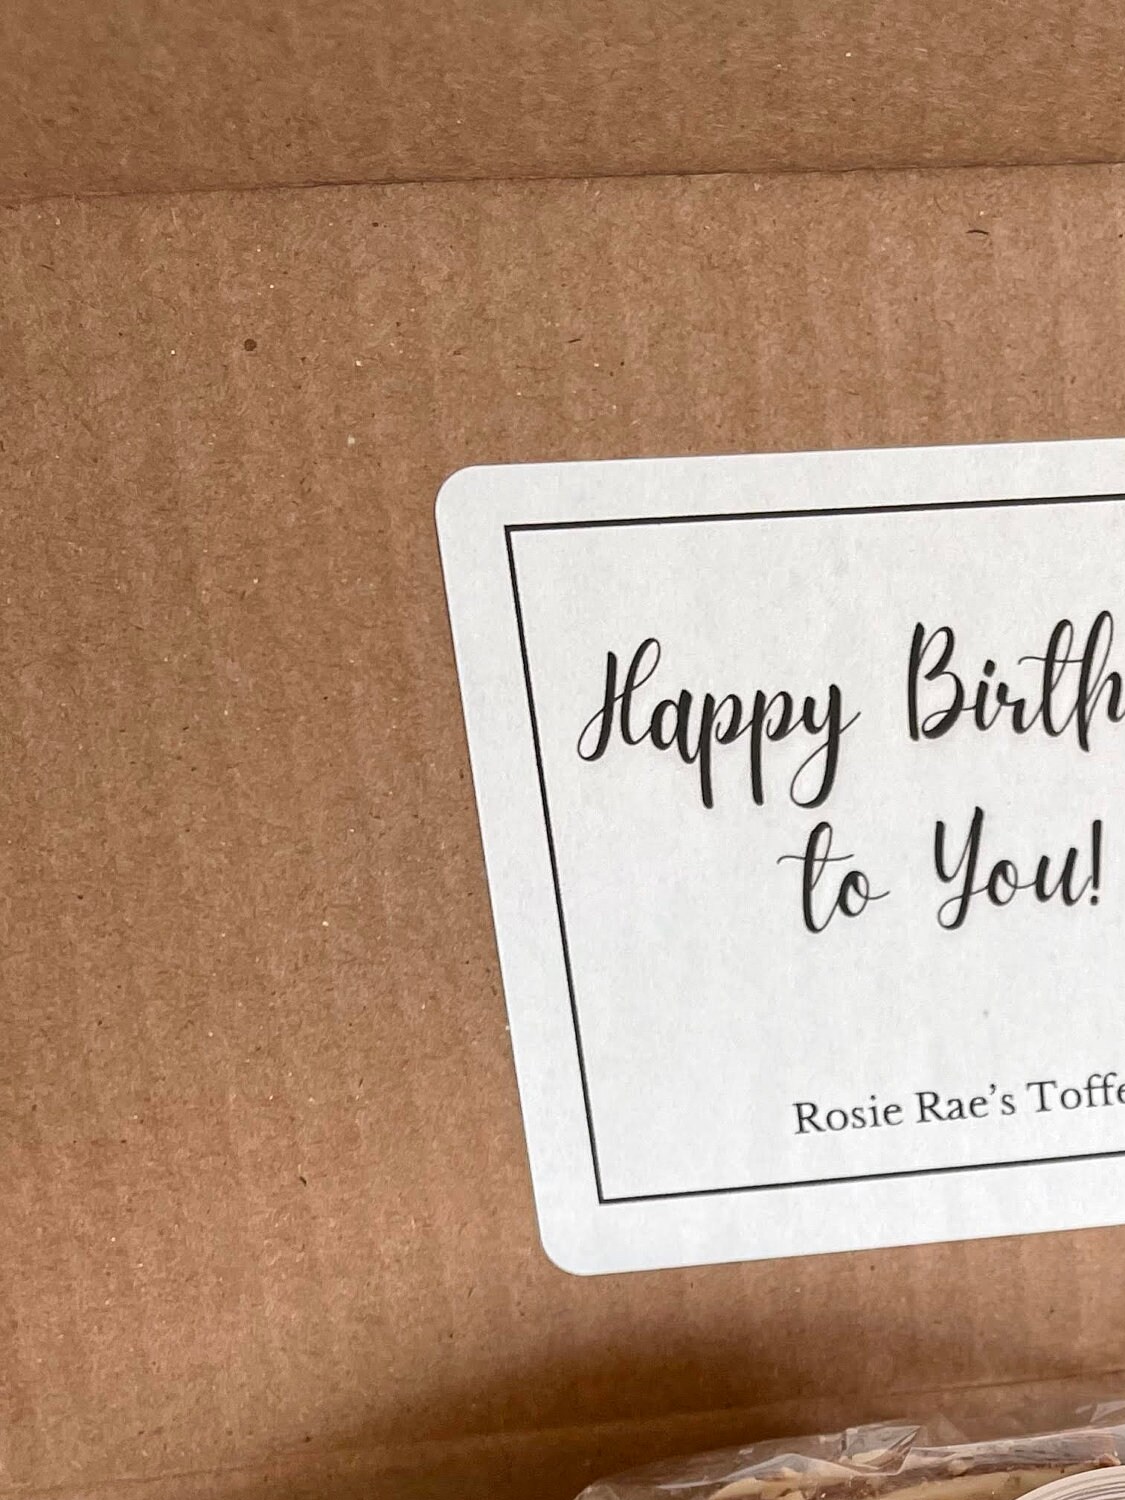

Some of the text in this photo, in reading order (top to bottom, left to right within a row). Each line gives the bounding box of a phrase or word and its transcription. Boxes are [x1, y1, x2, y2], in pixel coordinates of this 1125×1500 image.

[577, 636, 861, 809] Happy
[777, 806, 1104, 935] to You!
[793, 1092, 904, 1136] Rosie
[916, 1082, 1017, 1123] Rae's
